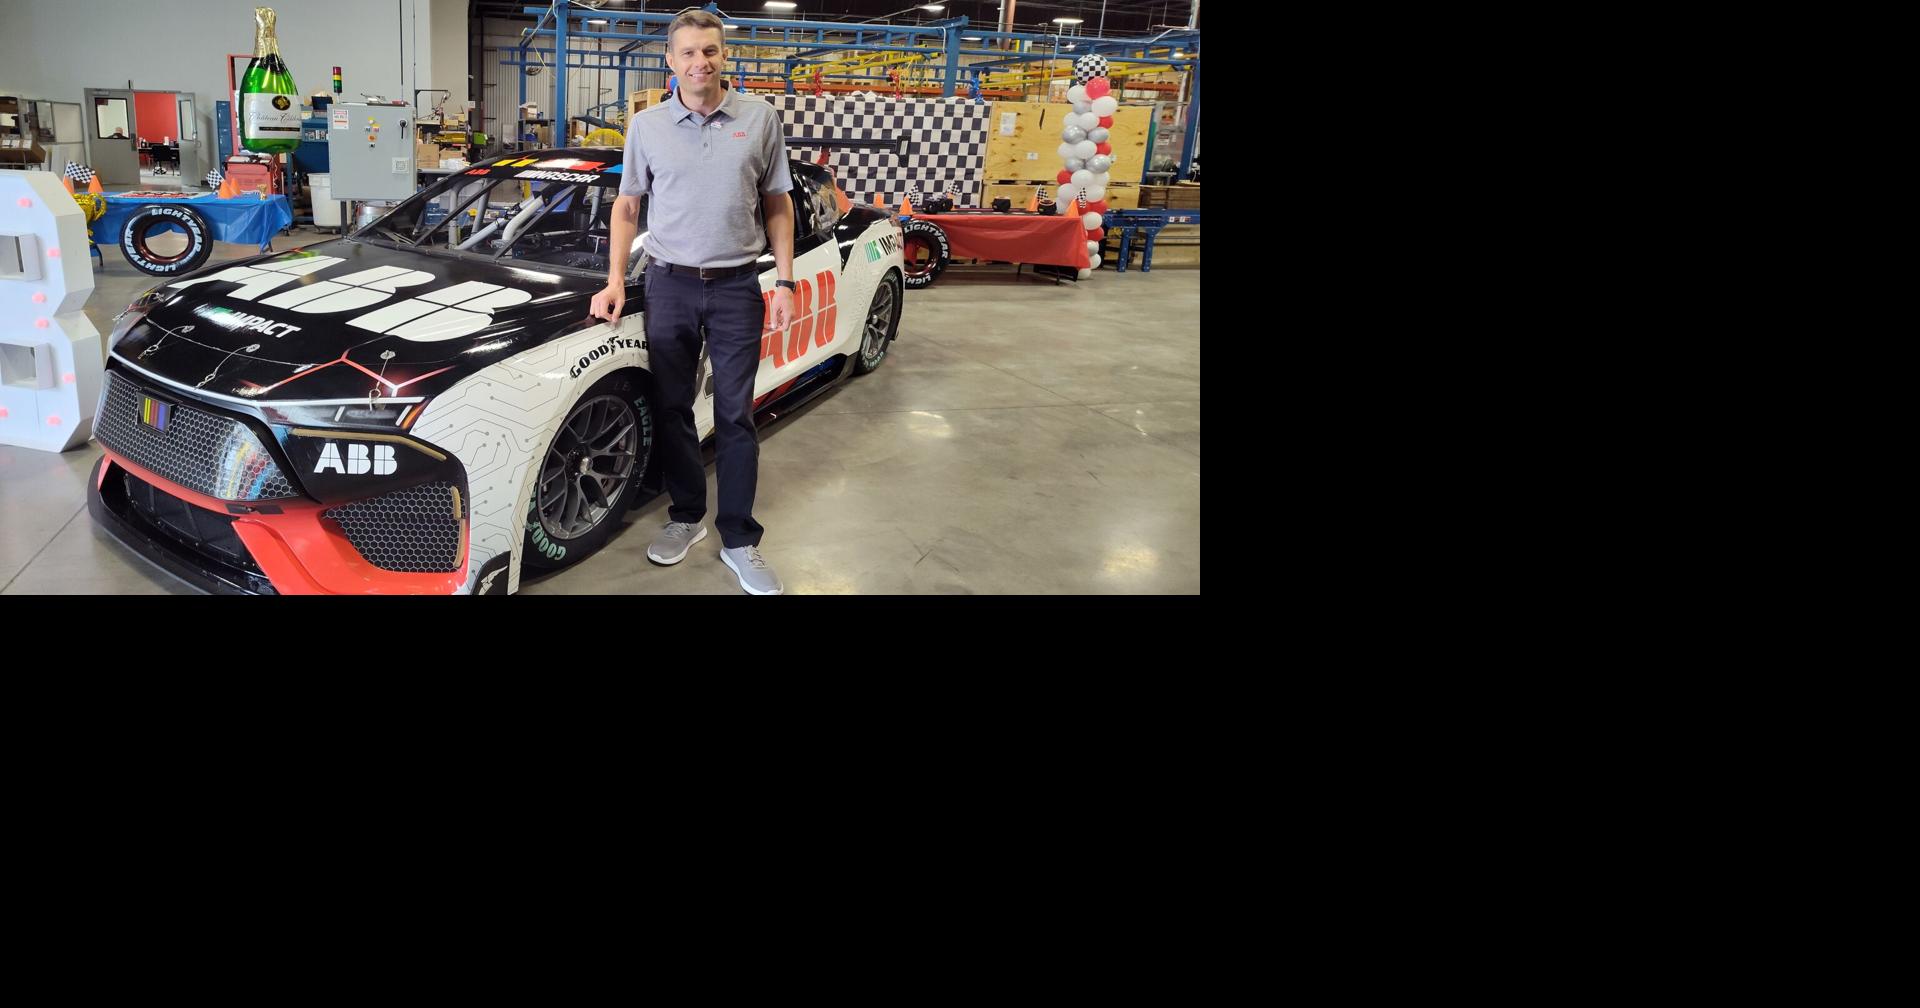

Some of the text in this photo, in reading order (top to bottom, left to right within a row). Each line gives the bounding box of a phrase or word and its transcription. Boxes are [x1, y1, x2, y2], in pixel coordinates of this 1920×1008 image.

[532, 170, 600, 184] NASCAR
[151, 208, 203, 252] LIGHTYEAR
[904, 224, 949, 258] LIGHTYEAR
[125, 229, 176, 272] LIGHTYEAR
[166, 255, 532, 342] ABB
[230, 311, 302, 338] IMPACT
[633, 394, 653, 447] EAGLE
[313, 442, 398, 475] ABB
